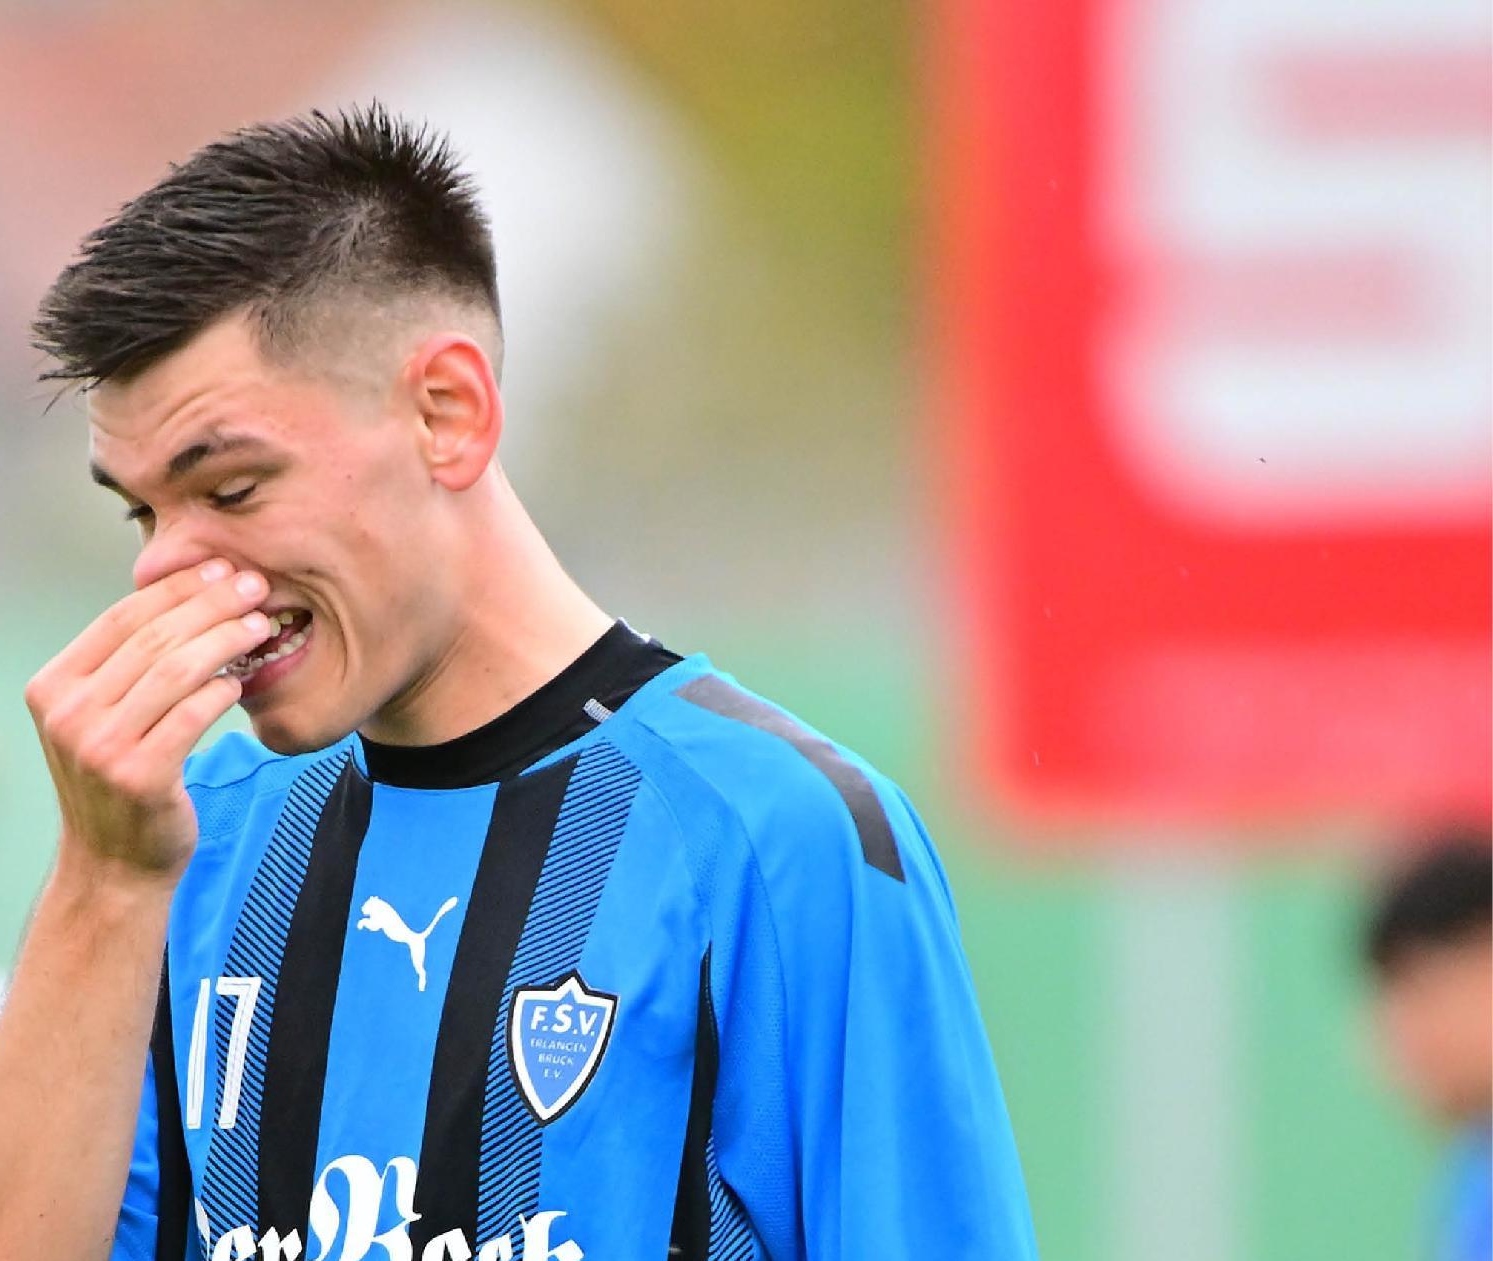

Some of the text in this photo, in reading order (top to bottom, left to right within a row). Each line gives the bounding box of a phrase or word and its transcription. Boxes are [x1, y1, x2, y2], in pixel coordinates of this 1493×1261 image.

[530, 1004, 598, 1037] F.S.V.
[187, 976, 262, 1129] 17
[530, 1037, 587, 1053] ERLANGEN
[538, 1053, 574, 1065] BRUCK
